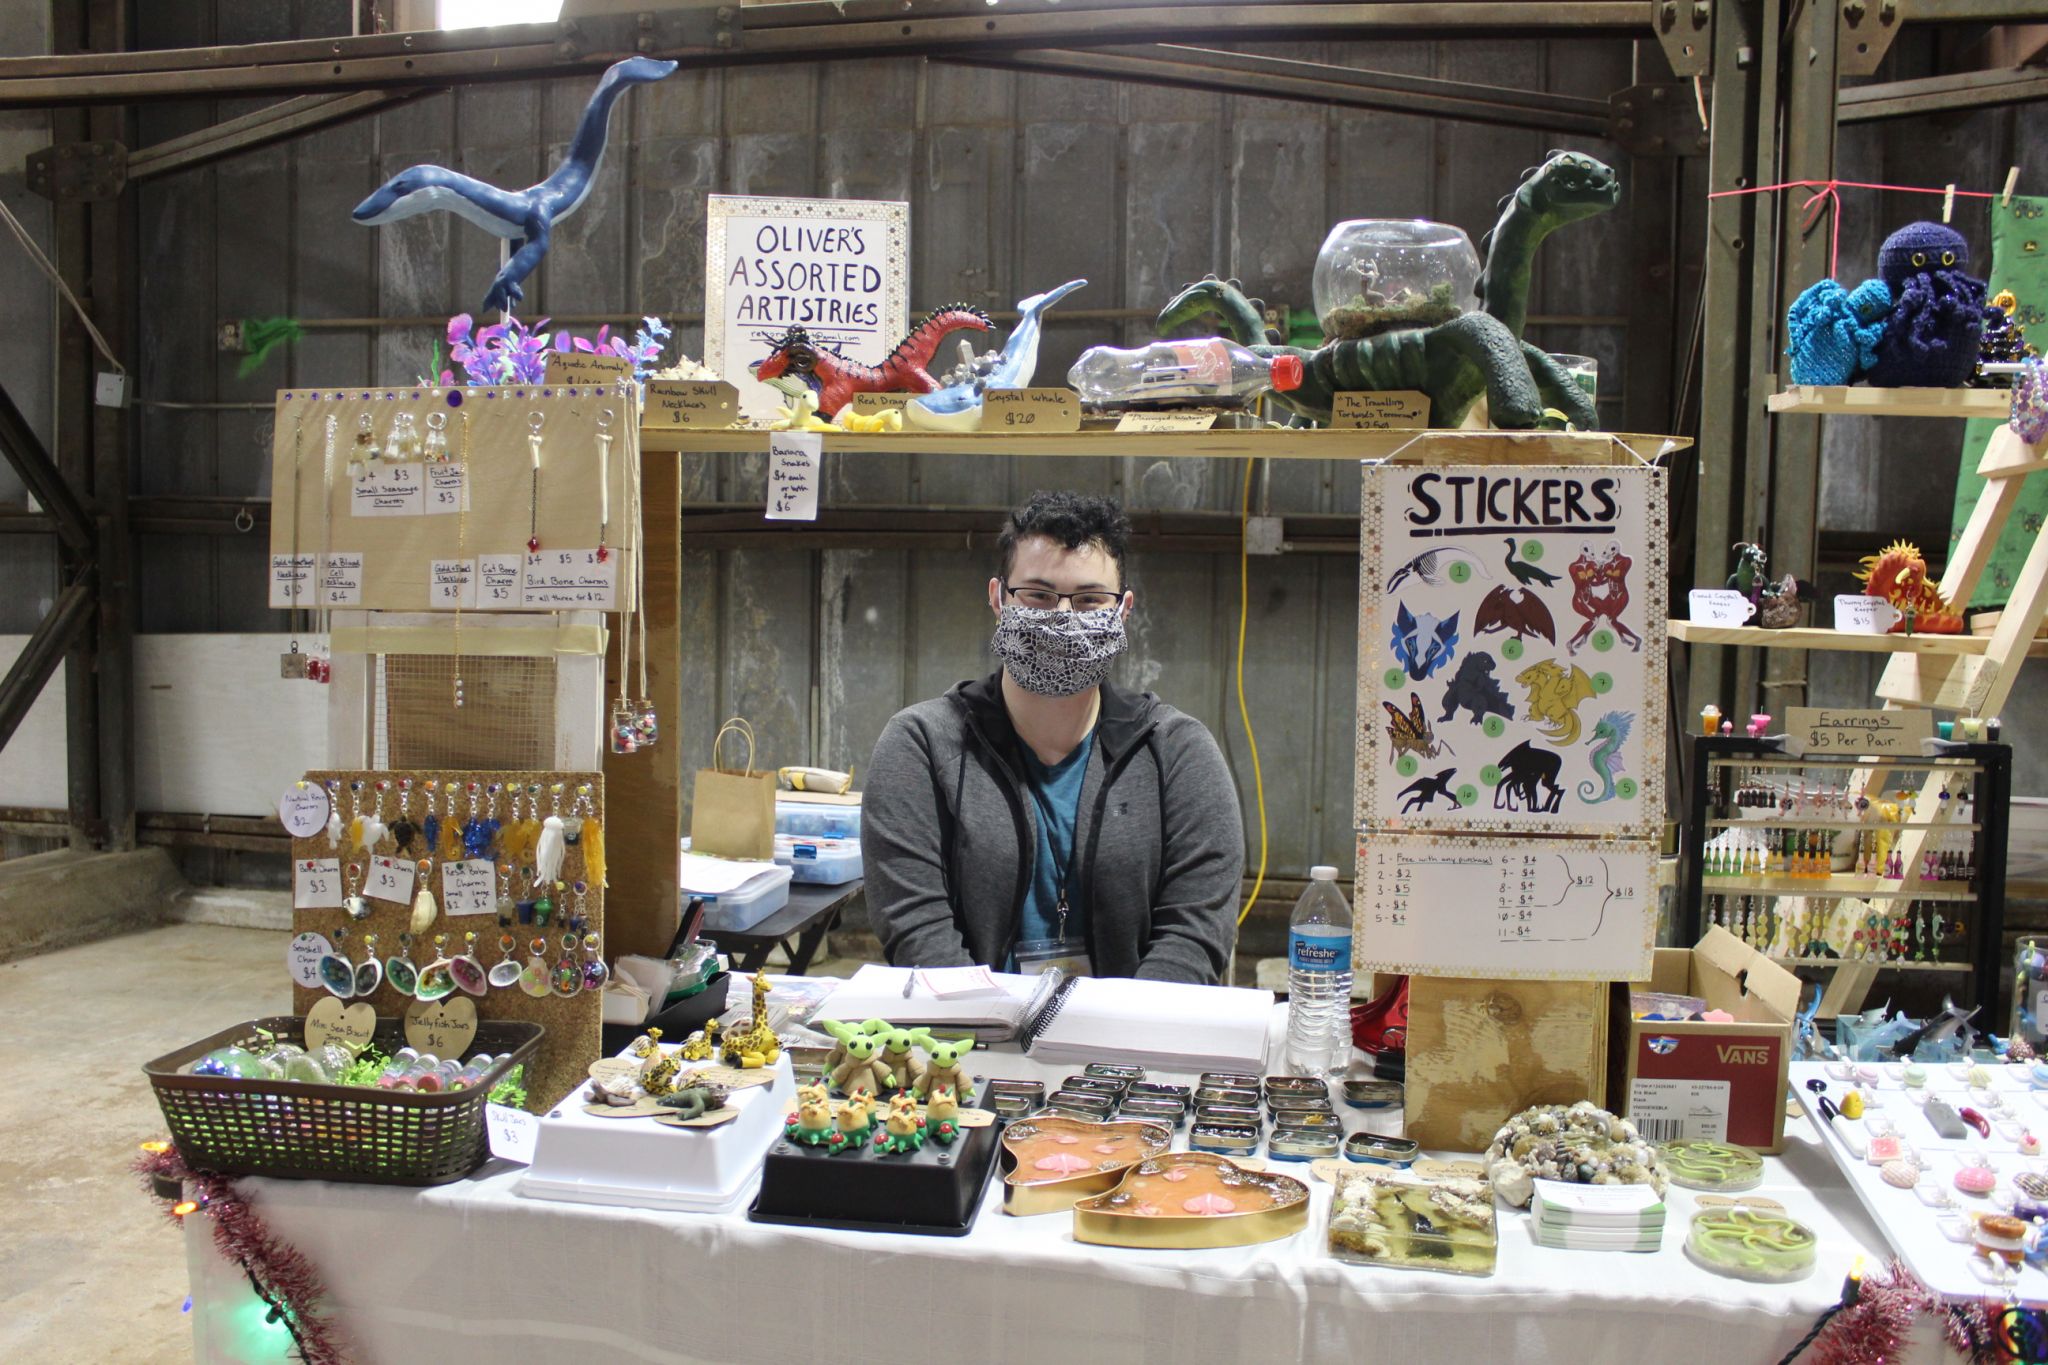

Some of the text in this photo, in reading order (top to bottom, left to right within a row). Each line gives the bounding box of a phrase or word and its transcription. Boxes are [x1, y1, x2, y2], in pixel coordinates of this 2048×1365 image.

[756, 225, 866, 255] OLIVER'S
[729, 256, 882, 293] ASSORTED
[737, 295, 878, 325] ARTISTRIES
[650, 384, 687, 397] Rainbow
[857, 396, 876, 405] Red
[986, 391, 1024, 404] Crystal
[661, 400, 706, 409] Necklaces
[672, 411, 690, 424] $6
[1005, 412, 1036, 426] $20
[772, 446, 807, 457] Banana
[781, 459, 811, 467] Snakes
[394, 469, 409, 482] $3
[773, 470, 786, 481] $4
[435, 478, 462, 486] Charms
[356, 487, 379, 496] Small
[375, 498, 405, 506] Charms
[438, 491, 455, 504] $3
[1409, 472, 1616, 525] STICKERS
[776, 500, 791, 512] $6
[1527, 545, 1536, 555] 2
[340, 557, 360, 567] Blood
[528, 555, 542, 566] $4
[560, 553, 572, 564] $5
[330, 569, 345, 578] Cell
[481, 563, 518, 574] Cat Bone
[486, 576, 513, 585] Charm
[526, 574, 608, 587] Bird Bone Charms
[331, 590, 348, 603] $4
[444, 585, 459, 598] $8
[493, 588, 509, 599] $5
[539, 593, 550, 601] all
[551, 593, 573, 601] three
[587, 592, 605, 602] $12
[1819, 711, 1890, 731] Earrings
[1808, 729, 1830, 747] $5
[1837, 733, 1858, 746] Per
[1622, 783, 1630, 793] 5
[294, 815, 310, 827] $2
[1396, 854, 1415, 863] Free
[1418, 855, 1437, 863] with
[1441, 857, 1455, 866] any
[1523, 855, 1537, 864] $4
[1396, 868, 1412, 879] $2
[1522, 868, 1535, 878] $4
[379, 874, 396, 888] $3
[456, 879, 486, 888] Charms
[1575, 874, 1593, 885] $12
[310, 879, 328, 893] $3
[1394, 883, 1410, 894] $5
[1520, 881, 1534, 891] $4
[1615, 886, 1634, 897] $18
[446, 900, 459, 910] $2
[1519, 894, 1533, 905] $4
[1393, 900, 1407, 911] $4
[1391, 913, 1406, 923] $4
[1518, 910, 1532, 921] $4
[1516, 926, 1530, 936] $4
[292, 943, 322, 954] Seashell
[1298, 947, 1336, 959] refreshe
[297, 955, 317, 963] Char
[303, 966, 317, 980] $4
[330, 1022, 345, 1033] Sea
[410, 1015, 434, 1030] Jelly
[450, 1017, 470, 1030] Jars
[427, 1035, 444, 1048] $6
[1716, 1045, 1770, 1065] VANS
[503, 1128, 518, 1144] $3
